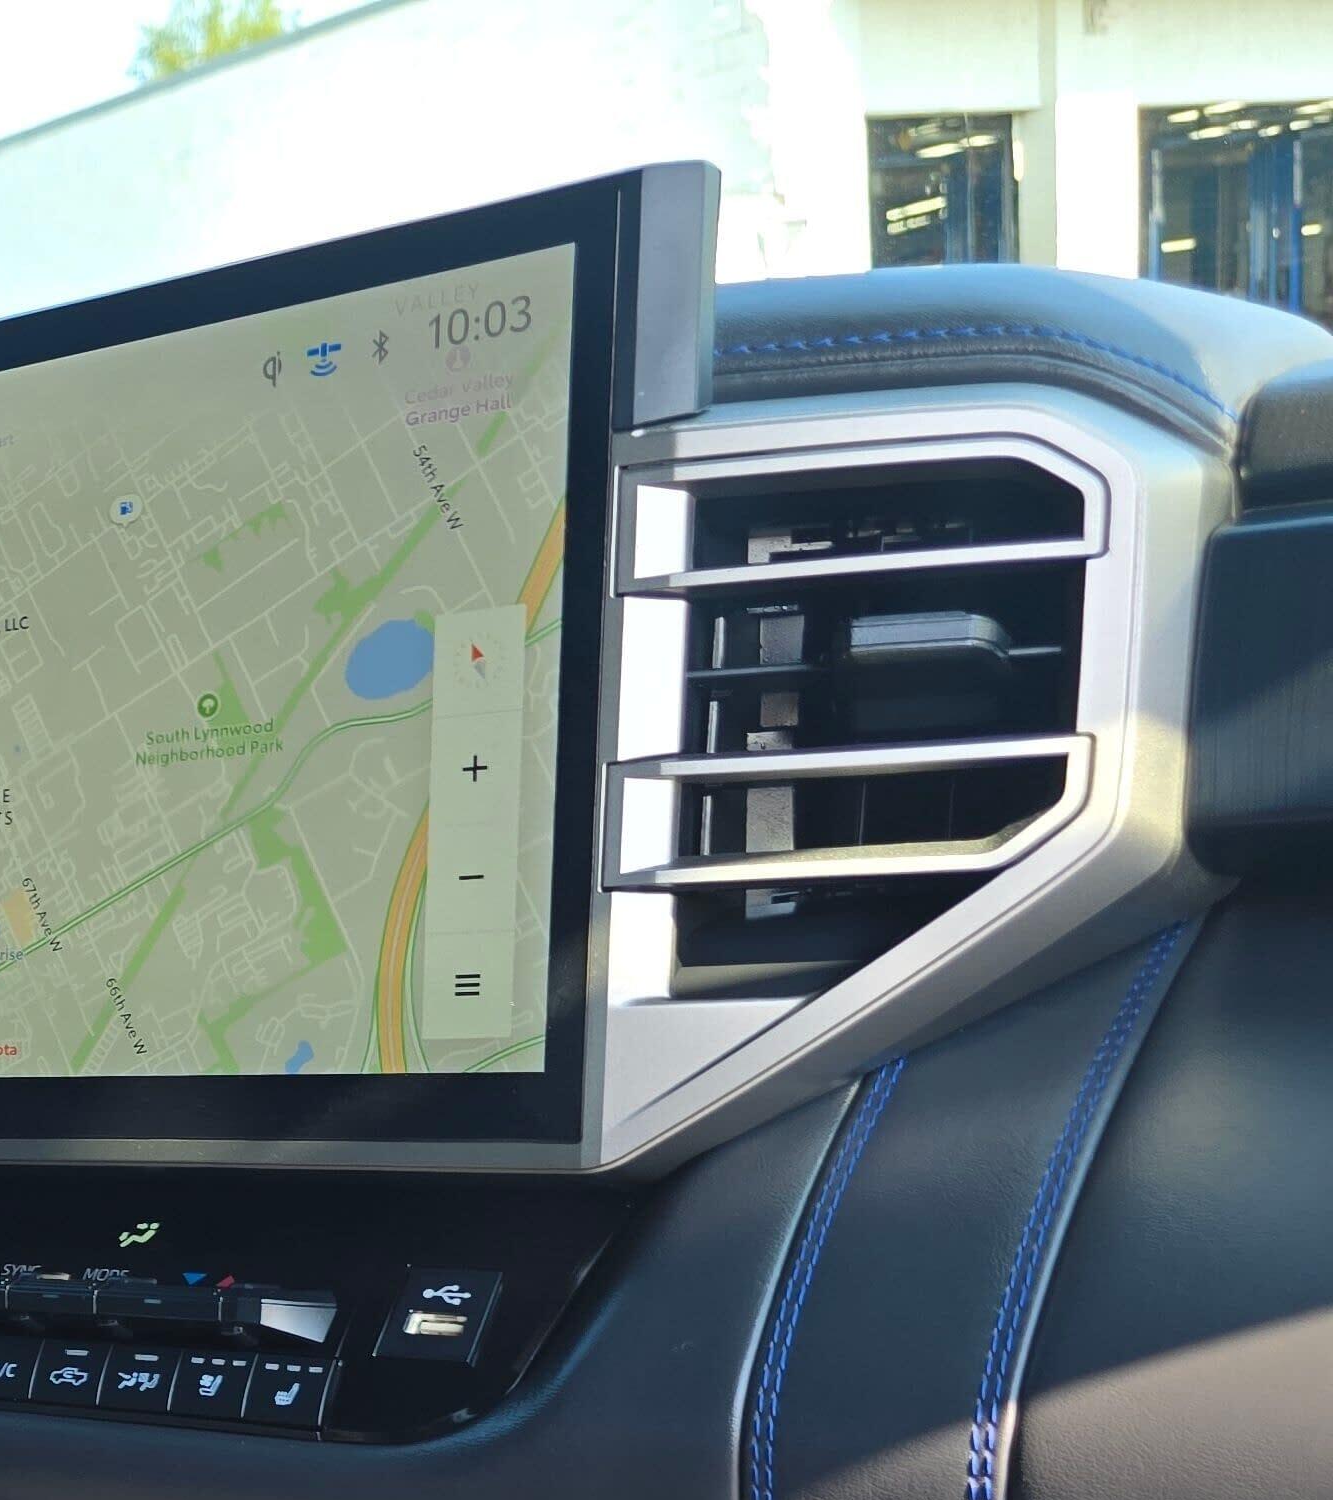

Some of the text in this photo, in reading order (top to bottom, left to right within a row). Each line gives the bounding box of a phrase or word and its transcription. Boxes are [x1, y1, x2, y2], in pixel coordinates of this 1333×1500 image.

[394, 281, 480, 317] VALLEY
[429, 296, 533, 349] 10:03
[405, 395, 512, 427] Grange Hall
[412, 445, 465, 530] 54th Ave W
[4, 616, 30, 632] LLC
[146, 718, 275, 746] South Lynnwood
[135, 738, 284, 767] Neighborhood Park
[22, 877, 63, 953] 67th Ave W
[106, 977, 147, 1056] 66th Ave W
